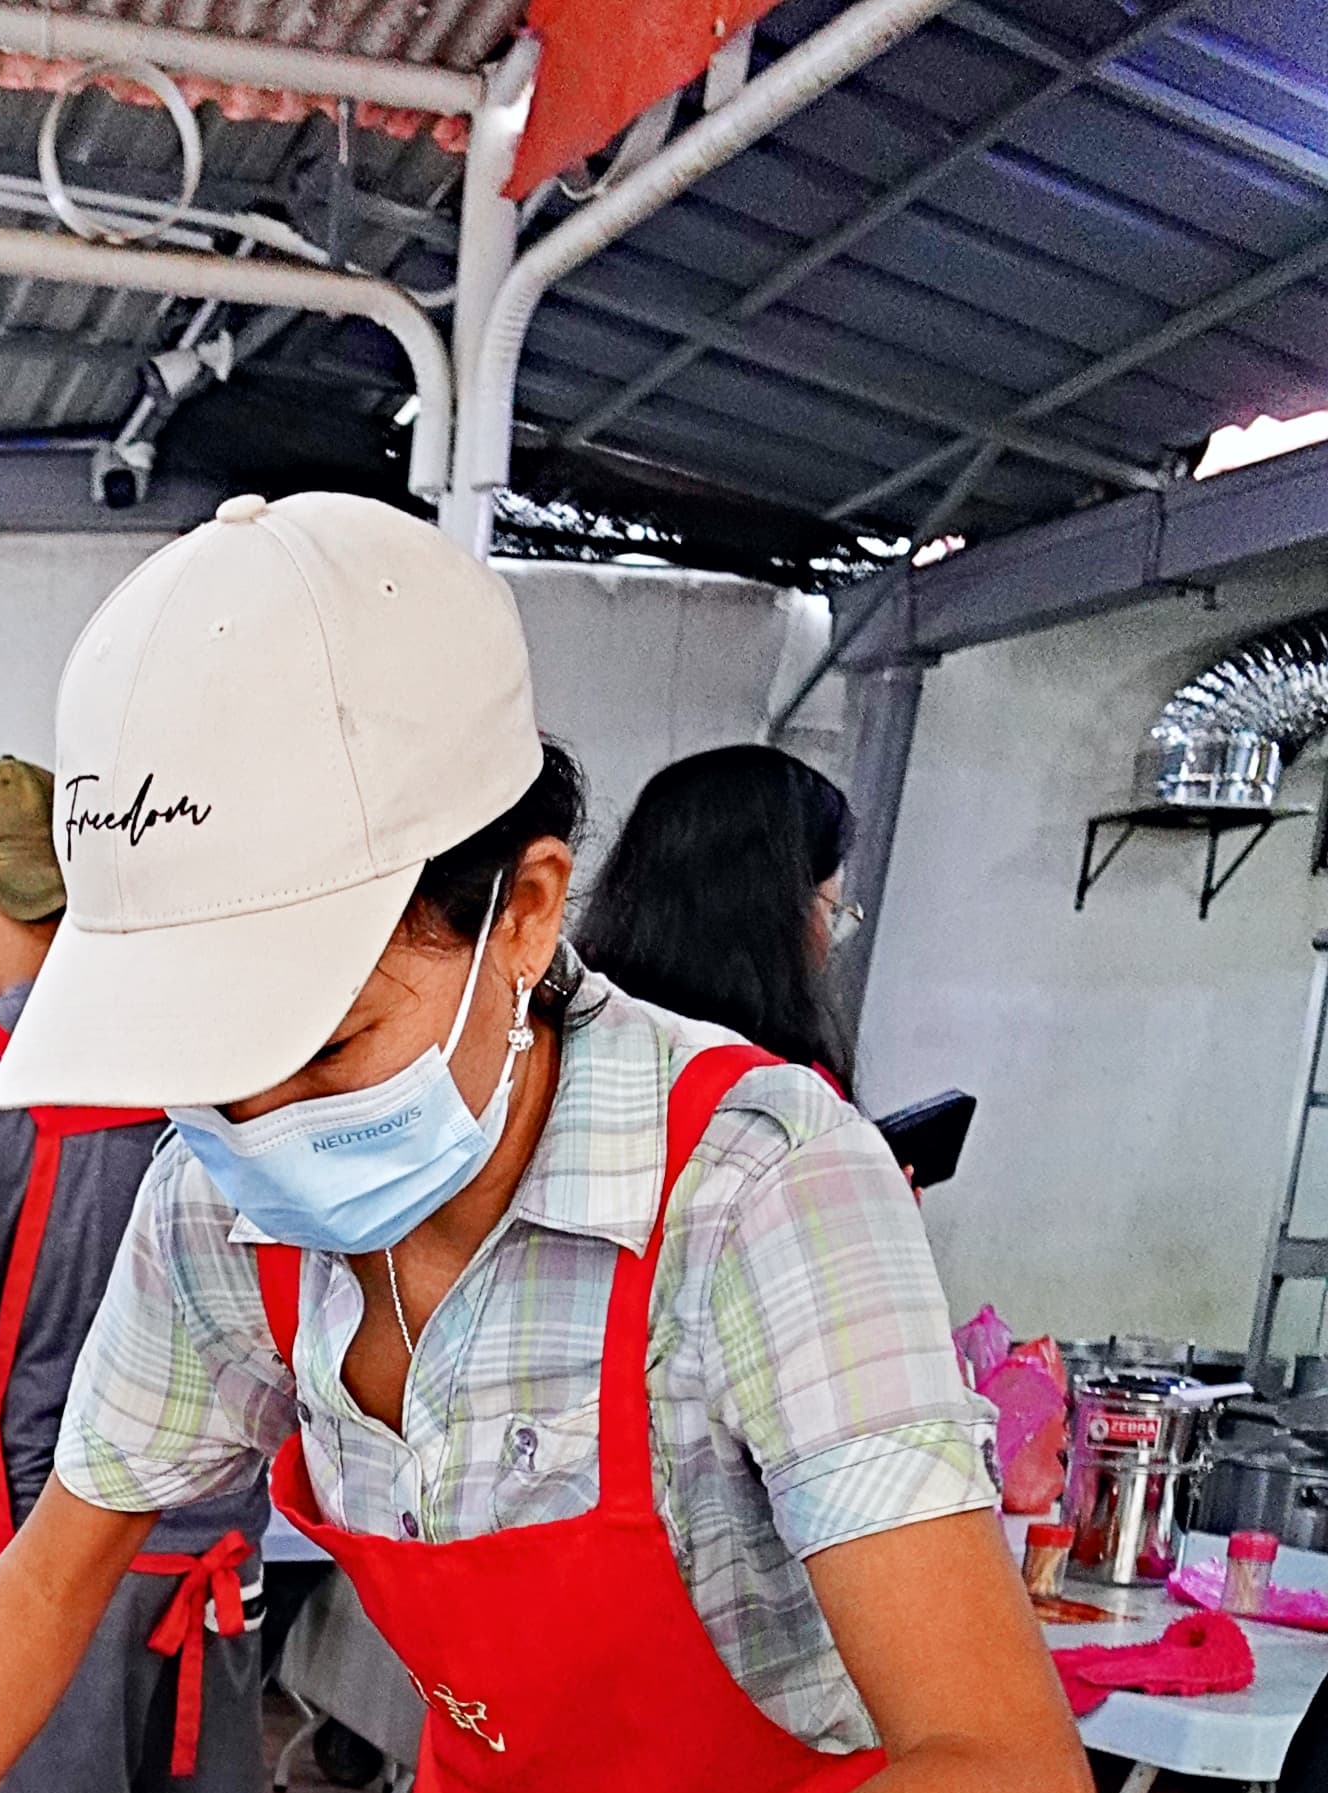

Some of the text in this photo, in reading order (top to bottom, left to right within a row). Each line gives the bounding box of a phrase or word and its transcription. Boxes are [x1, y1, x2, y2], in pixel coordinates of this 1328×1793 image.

[65, 773, 212, 862] Freedom
[312, 1105, 422, 1153] NEUTROVIS
[1111, 1420, 1157, 1434] ZEBRA
